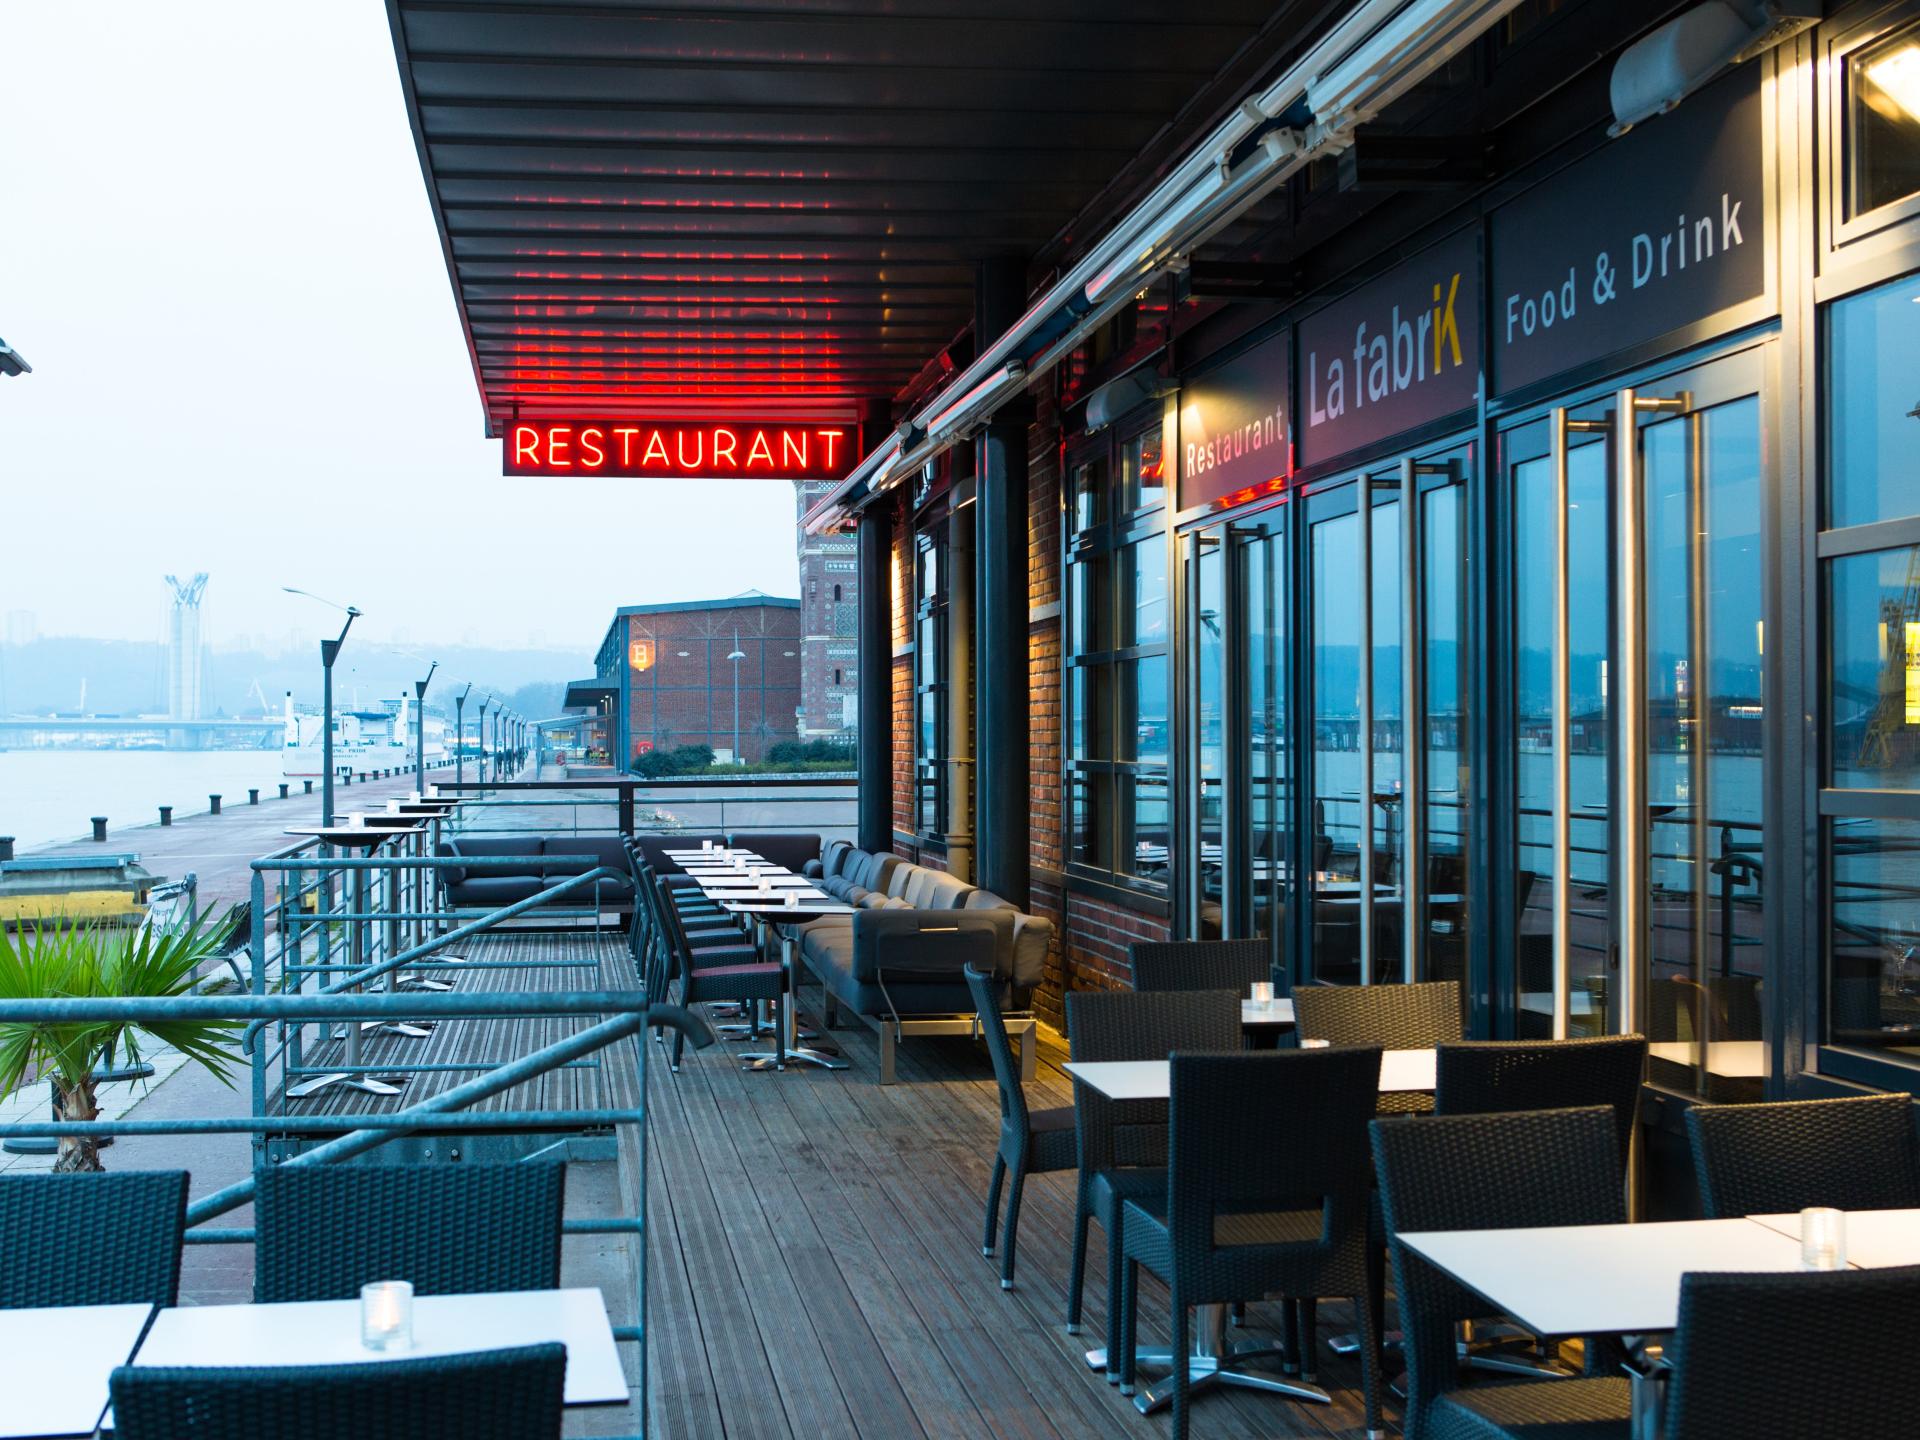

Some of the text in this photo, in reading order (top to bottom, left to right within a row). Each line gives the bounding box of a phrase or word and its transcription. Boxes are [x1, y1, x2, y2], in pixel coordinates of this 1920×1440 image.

[1507, 193, 1744, 344] Food & Drink
[1310, 272, 1464, 428] La fabriK
[514, 425, 845, 470] RESTAURANT
[1186, 404, 1284, 478] Restaurant
